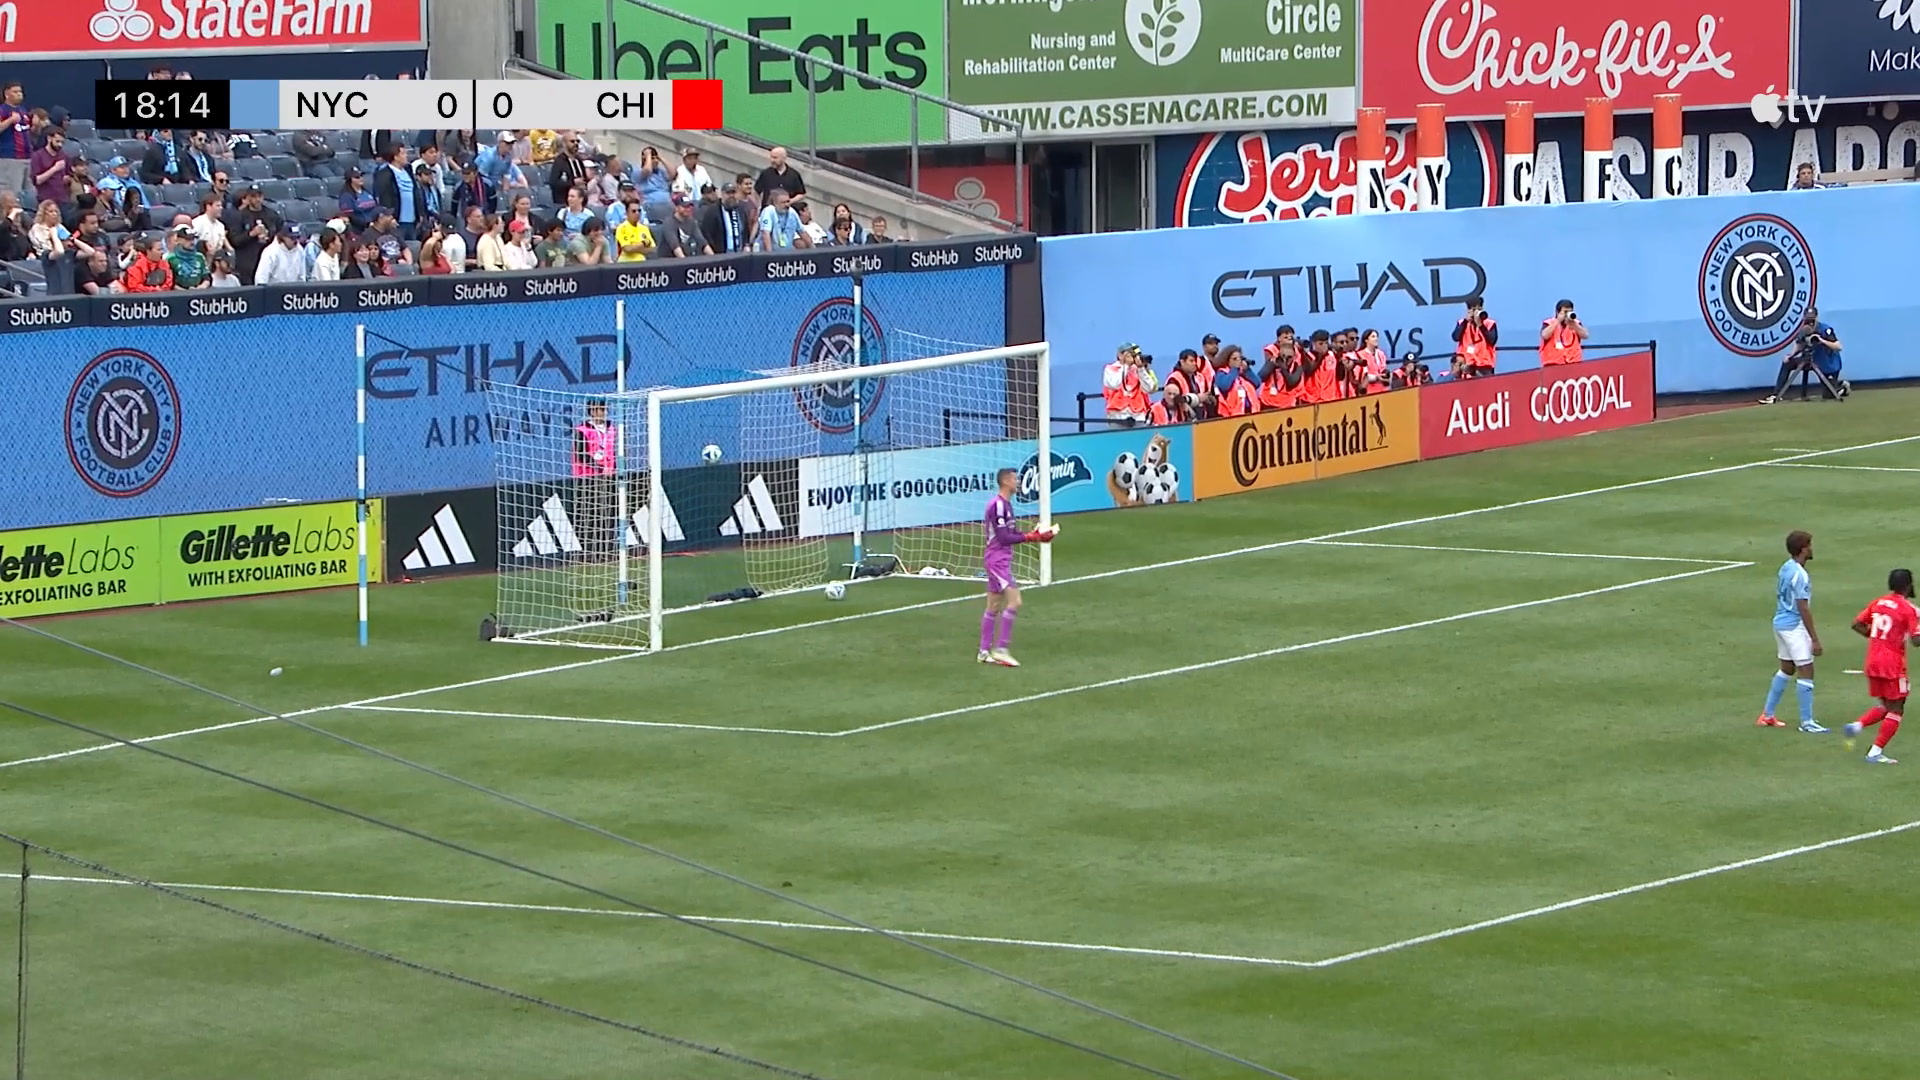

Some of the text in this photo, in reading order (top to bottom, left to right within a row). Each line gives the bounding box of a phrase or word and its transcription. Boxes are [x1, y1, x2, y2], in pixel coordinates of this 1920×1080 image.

[1265, 0, 1342, 35] Circle
[1030, 30, 1116, 51] Nursing and
[1417, 0, 1735, 98] Chick-fil-A
[747, 16, 927, 95] Eats
[964, 54, 1117, 76] Rehabilitation Center
[1220, 44, 1342, 64] MultiCare Center
[978, 93, 1328, 133] WWW.CASSENACARE.COM
[911, 249, 959, 268] StubHub
[974, 244, 1022, 263] StubHub
[1709, 225, 1806, 277] NEW YORK CITY
[617, 272, 669, 291] StubHub
[686, 266, 736, 285] StubHub
[767, 260, 816, 279] StubHub
[358, 288, 413, 308] StubHub
[454, 283, 508, 301] StubHub
[525, 278, 576, 297] StubHub
[1211, 257, 1487, 319] ETIHAD
[110, 302, 170, 321] StubHub
[189, 298, 247, 317] StubHub
[283, 293, 339, 312] StubHub
[9, 306, 72, 327] StubHub
[1710, 290, 1807, 346] FOOTBALL CLUB
[366, 334, 631, 399] ETIHAD
[76, 359, 170, 414] NEW YORK CITY
[1446, 392, 1510, 437] Audi
[76, 429, 172, 487] FOOTBALL CLUB
[1231, 405, 1368, 487] Continental
[1022, 457, 1076, 495] Chmin
[808, 485, 854, 510] ENJOY
[860, 483, 886, 502] THE
[188, 559, 347, 588] WITH EXFOLIATING BAR
[98, 579, 127, 595] BAR
[1870, 613, 1893, 640] 19
